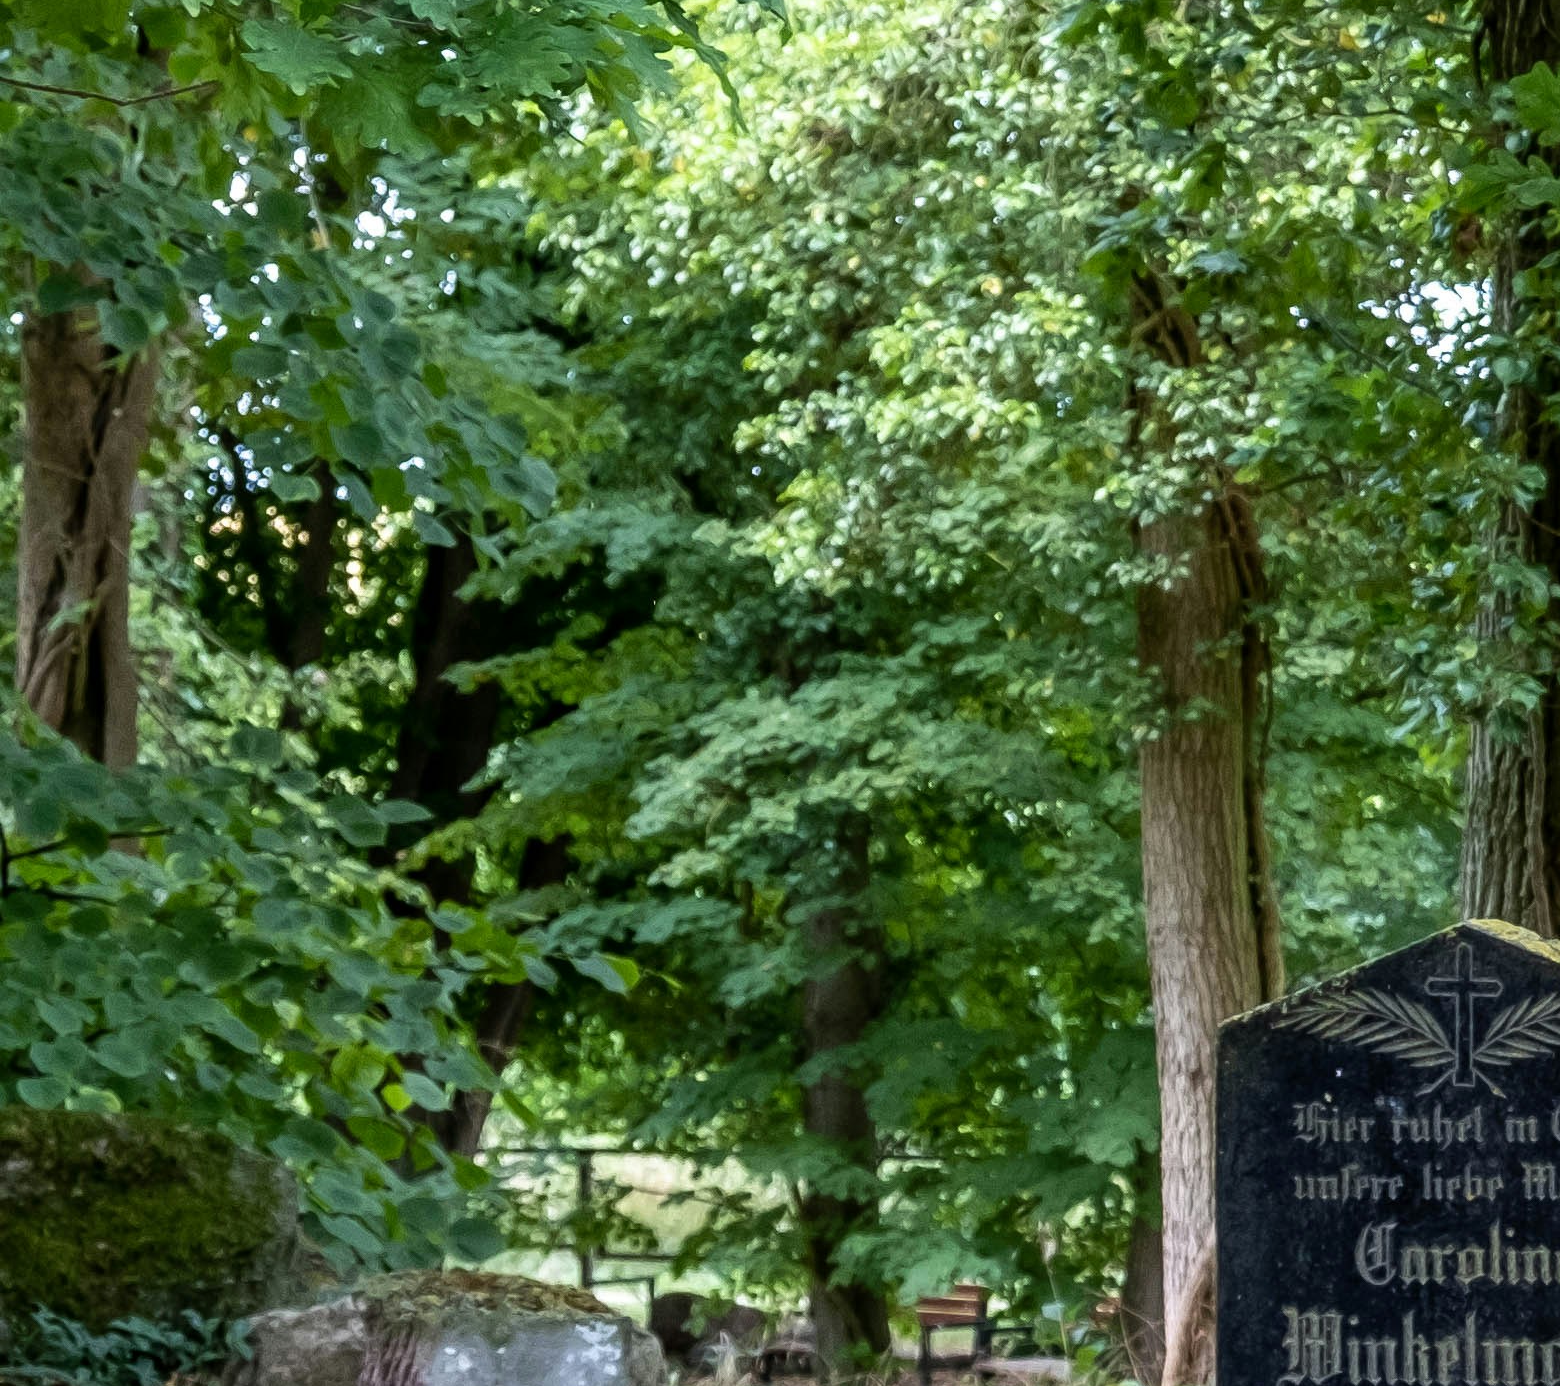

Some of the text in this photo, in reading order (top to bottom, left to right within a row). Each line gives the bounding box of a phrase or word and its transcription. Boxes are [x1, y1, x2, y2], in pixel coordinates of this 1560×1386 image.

[1292, 1101, 1376, 1148] Hier
[1391, 1103, 1486, 1150] ruhet
[1504, 1105, 1539, 1144] in
[1421, 1161, 1505, 1203] liebe
